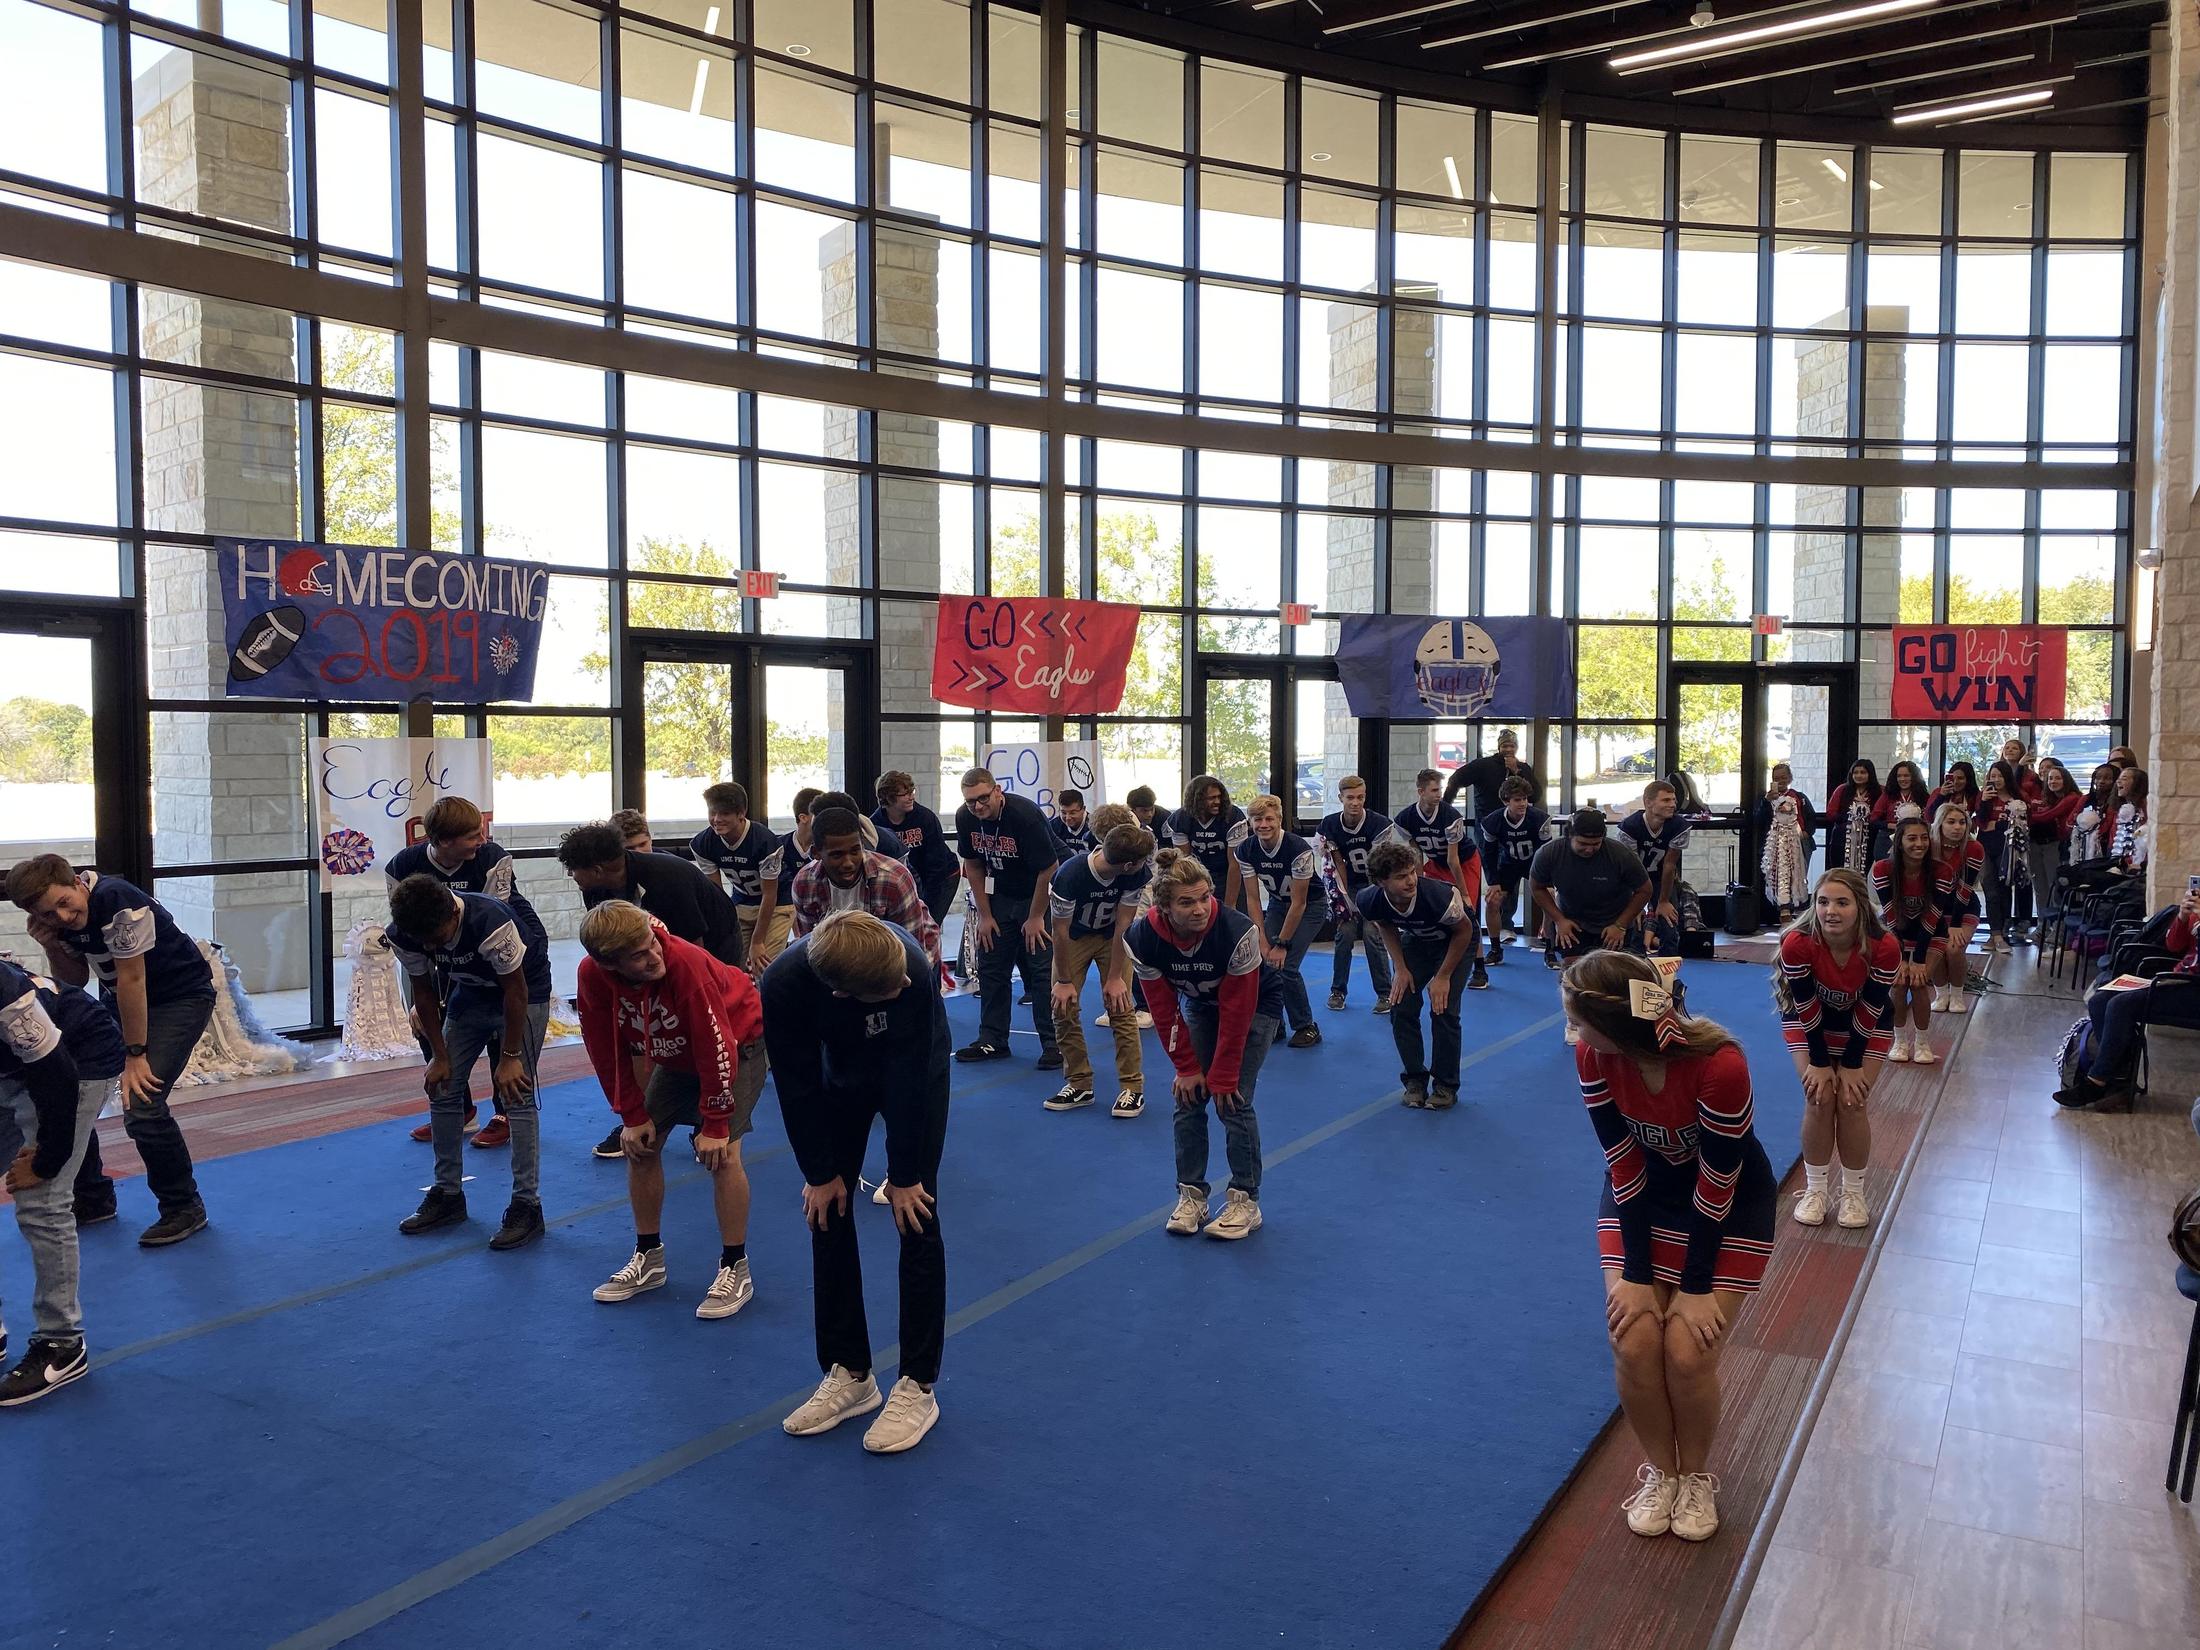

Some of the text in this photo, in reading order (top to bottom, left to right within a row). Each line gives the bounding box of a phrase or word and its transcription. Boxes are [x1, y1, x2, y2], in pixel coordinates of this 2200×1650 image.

[746, 571, 774, 597] EXIT
[964, 600, 1016, 651] GO
[1287, 604, 1308, 625] EXIT
[1759, 615, 1779, 634] EXIT
[311, 608, 481, 685] 2019
[1898, 628, 2044, 686] GO fight
[1014, 643, 1095, 699] Eagles
[1921, 675, 2036, 712] WIN
[322, 744, 453, 818] Eagle
[1506, 839, 1534, 861] 10
